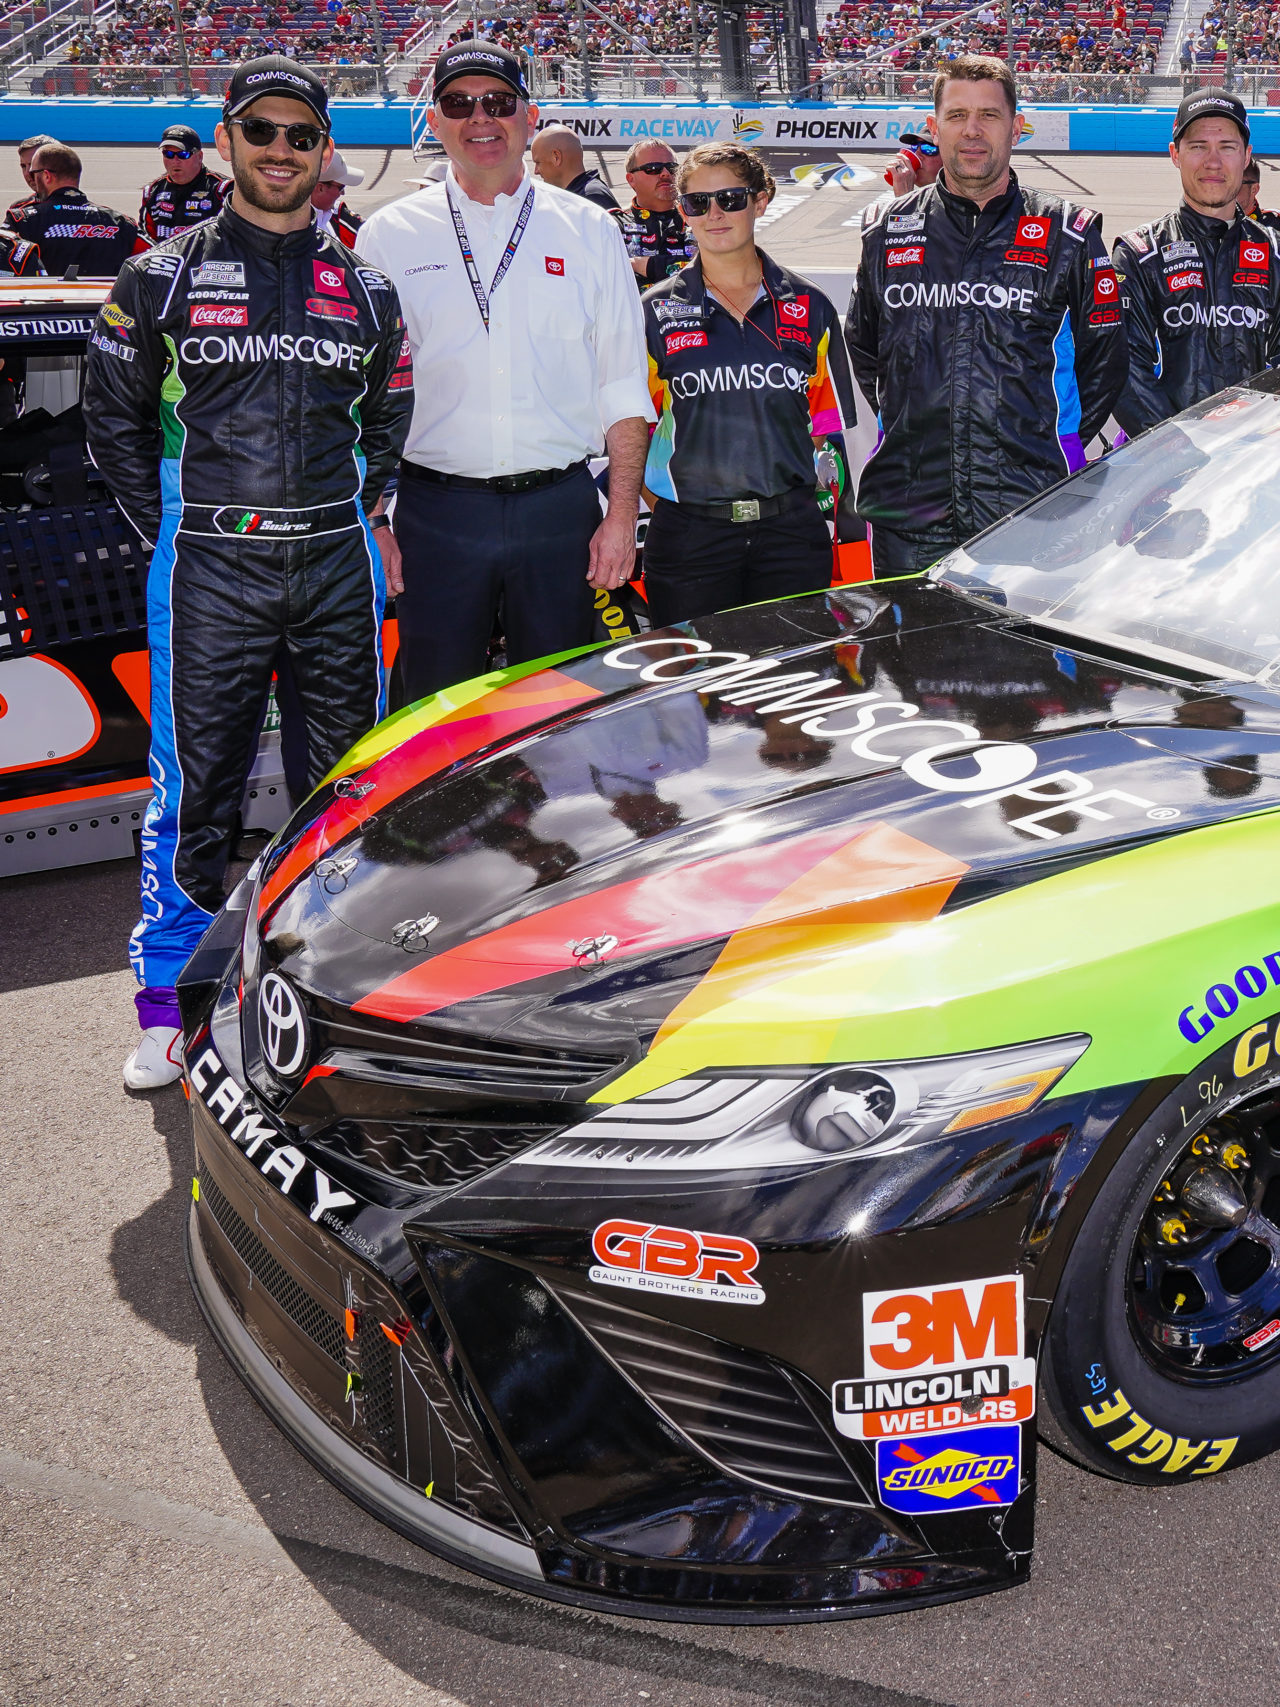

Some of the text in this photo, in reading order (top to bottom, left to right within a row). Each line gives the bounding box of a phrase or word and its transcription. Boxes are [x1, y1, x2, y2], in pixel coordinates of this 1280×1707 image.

[446, 52, 506, 67] COMMSCOPE
[246, 72, 312, 90] COMMSCOPE
[1187, 98, 1235, 112] COMMSCOPE
[619, 119, 722, 137] RACEWAY
[776, 120, 878, 139] PHOENIX
[72, 224, 119, 238] RCR
[205, 263, 236, 272] NASCAR
[887, 248, 922, 266] Coca-Cola
[1004, 249, 1048, 267] GBR
[404, 263, 447, 277] COMMSCOPE
[187, 290, 250, 301] GOODYEAR
[884, 280, 1034, 313] COMMSCOPE
[101, 306, 133, 328] UNOCO
[193, 307, 246, 325] Coca-Cola
[305, 297, 358, 322] GBR
[180, 334, 364, 372] COMMSCOPE
[602, 637, 1156, 840] COMMSCOPE
[1198, 1074, 1224, 1105] 96
[592, 1218, 763, 1288] GBR
[592, 1269, 759, 1301] GAUNT BROTHERS RACING
[869, 1281, 1019, 1371] 3M
[843, 1368, 1002, 1413] LINCOLN
[879, 1399, 1018, 1435] WELDERS
[1080, 1387, 1241, 1475] EAGLE
[889, 1456, 1010, 1491] SUNOCO
